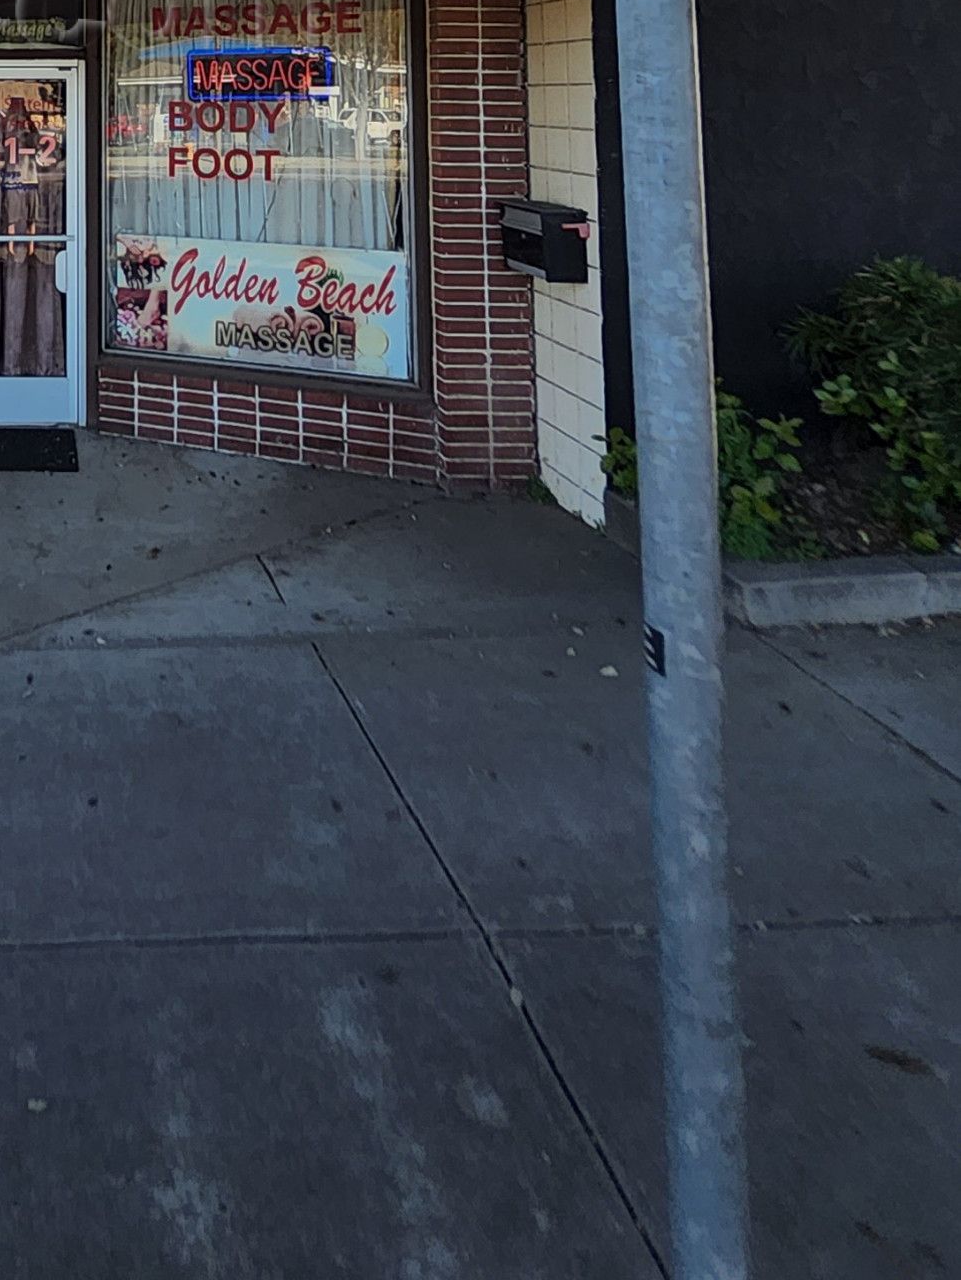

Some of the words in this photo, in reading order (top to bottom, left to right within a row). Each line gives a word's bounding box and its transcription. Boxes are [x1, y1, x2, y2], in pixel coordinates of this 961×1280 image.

[152, 0, 363, 38] MASSAGE
[195, 57, 320, 91] MASSAGE
[168, 101, 285, 133] BODY
[168, 147, 281, 181] FOOT
[171, 247, 281, 315] Golden
[294, 255, 398, 316] Beach
[215, 320, 355, 360] MASSAGE
